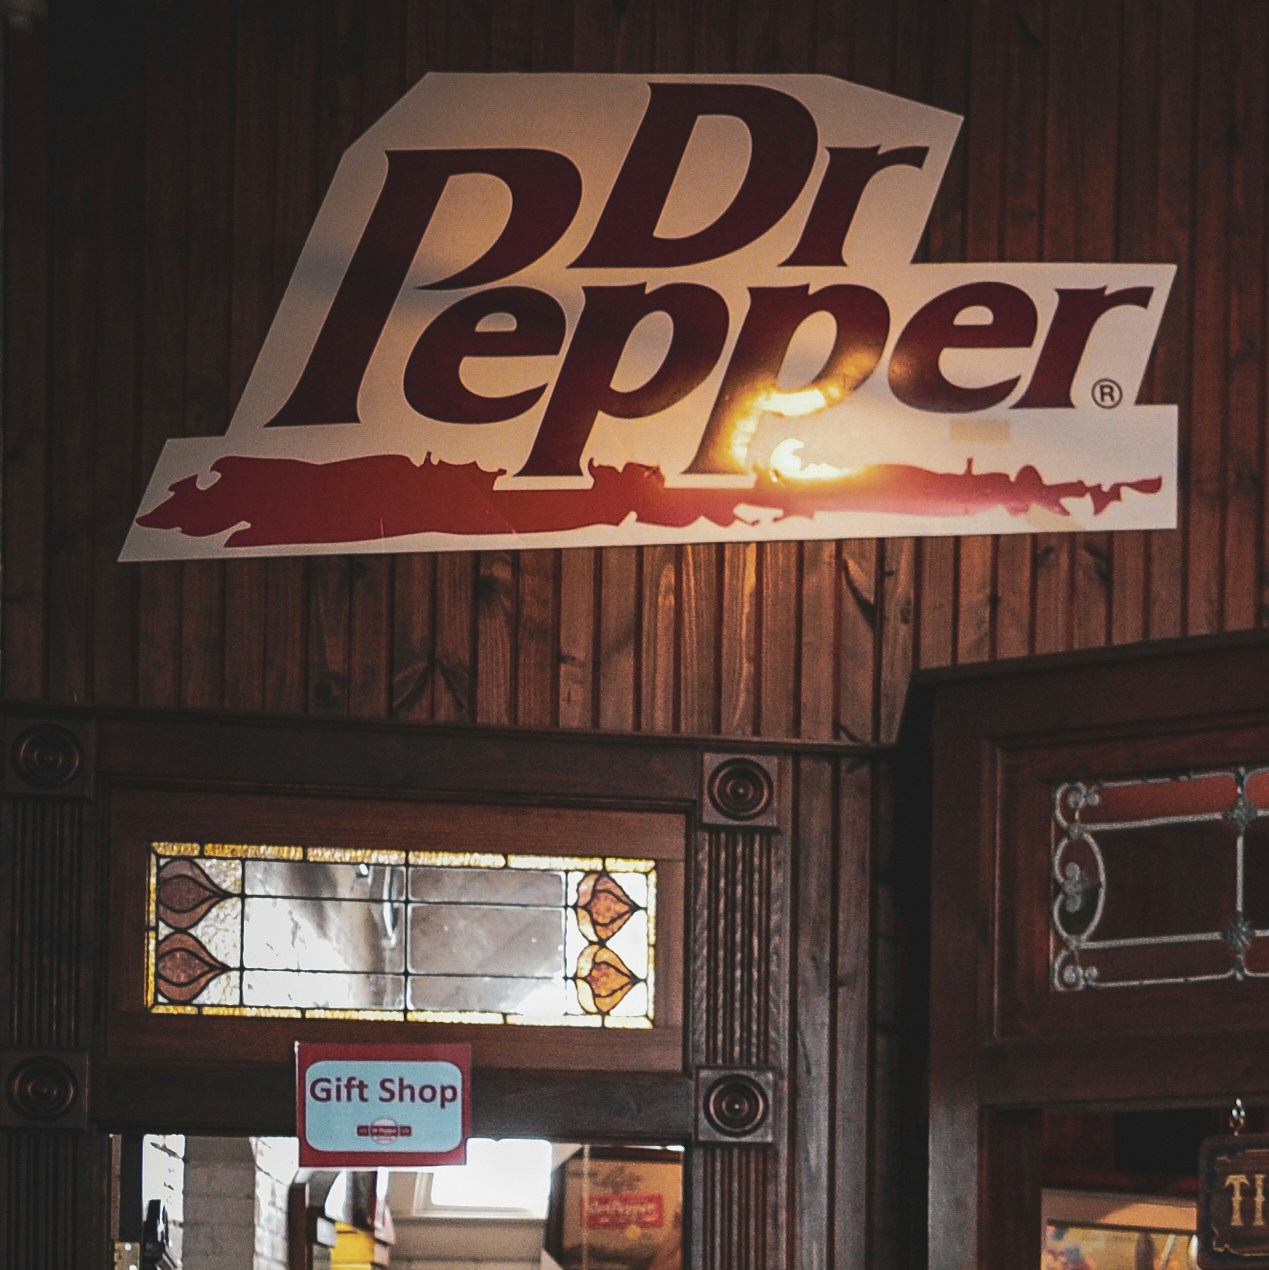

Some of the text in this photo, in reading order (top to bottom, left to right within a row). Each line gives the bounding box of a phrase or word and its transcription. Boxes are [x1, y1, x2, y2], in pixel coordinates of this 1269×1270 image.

[564, 81, 930, 271] Dr
[262, 146, 1157, 480] Pepper
[309, 1076, 458, 1110] Gift Shop
